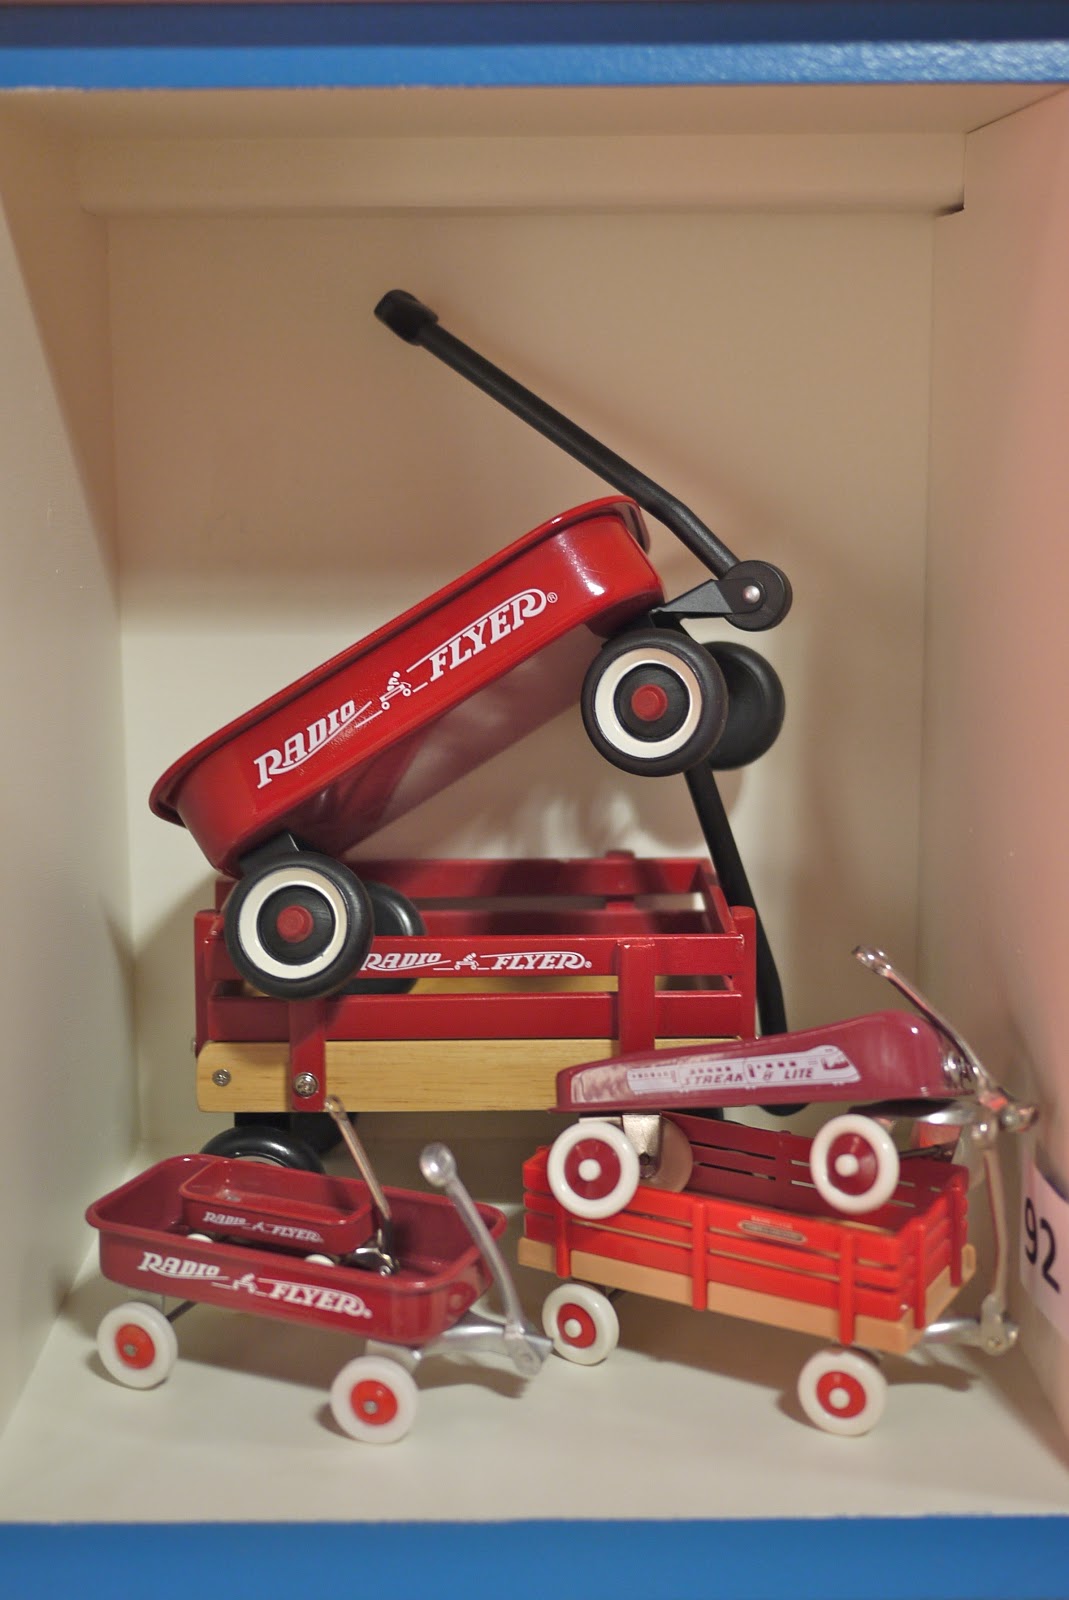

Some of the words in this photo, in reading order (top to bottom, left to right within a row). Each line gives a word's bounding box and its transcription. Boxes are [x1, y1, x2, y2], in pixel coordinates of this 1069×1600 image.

[252, 699, 356, 789] RADIO
[359, 952, 442, 972] RADIO
[783, 1068, 813, 1080] LITE
[202, 1210, 246, 1225] RADIO
[1024, 1197, 1061, 1294] 92
[137, 1251, 221, 1279] RADIO
